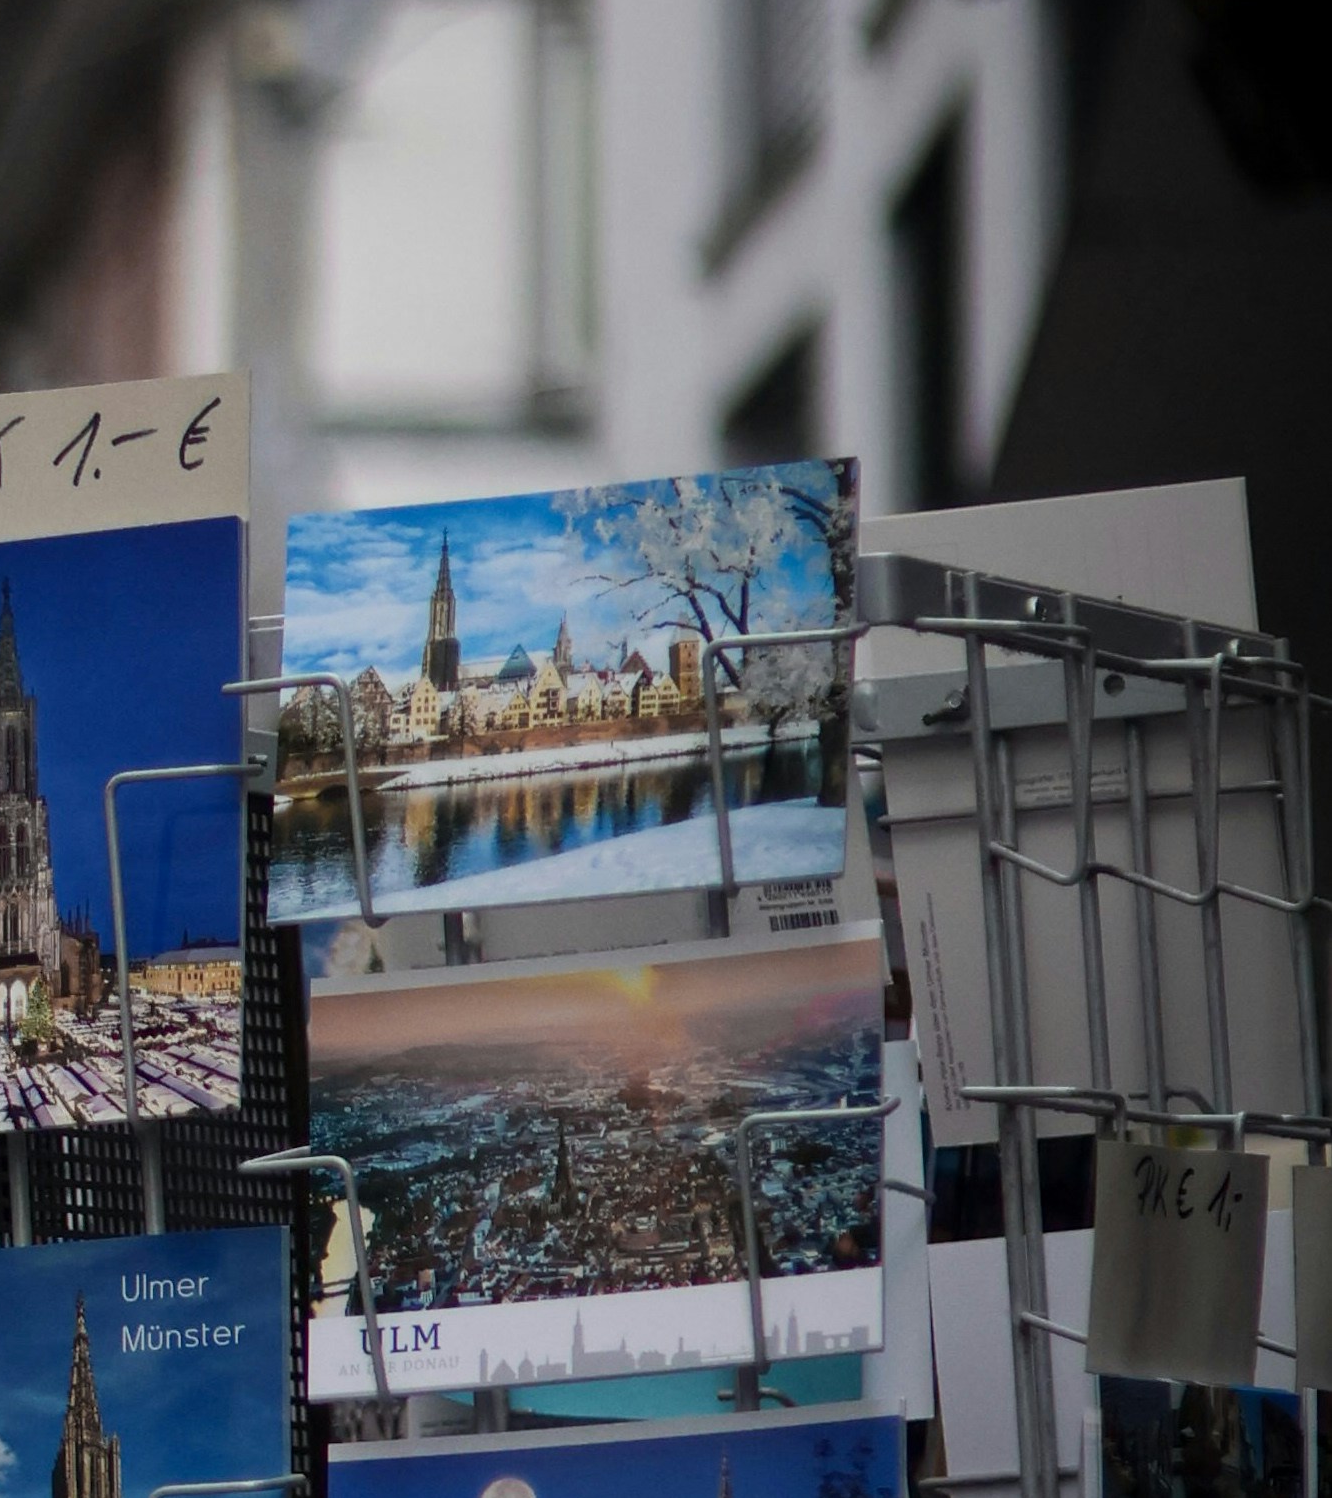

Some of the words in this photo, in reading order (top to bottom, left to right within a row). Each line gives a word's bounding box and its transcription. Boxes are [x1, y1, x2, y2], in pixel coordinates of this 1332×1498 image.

[178, 397, 221, 470] €
[120, 1272, 209, 1303] Ulmer
[120, 1320, 246, 1354] Münster
[359, 1322, 442, 1356] ULM
[403, 1356, 461, 1373] DONAU
